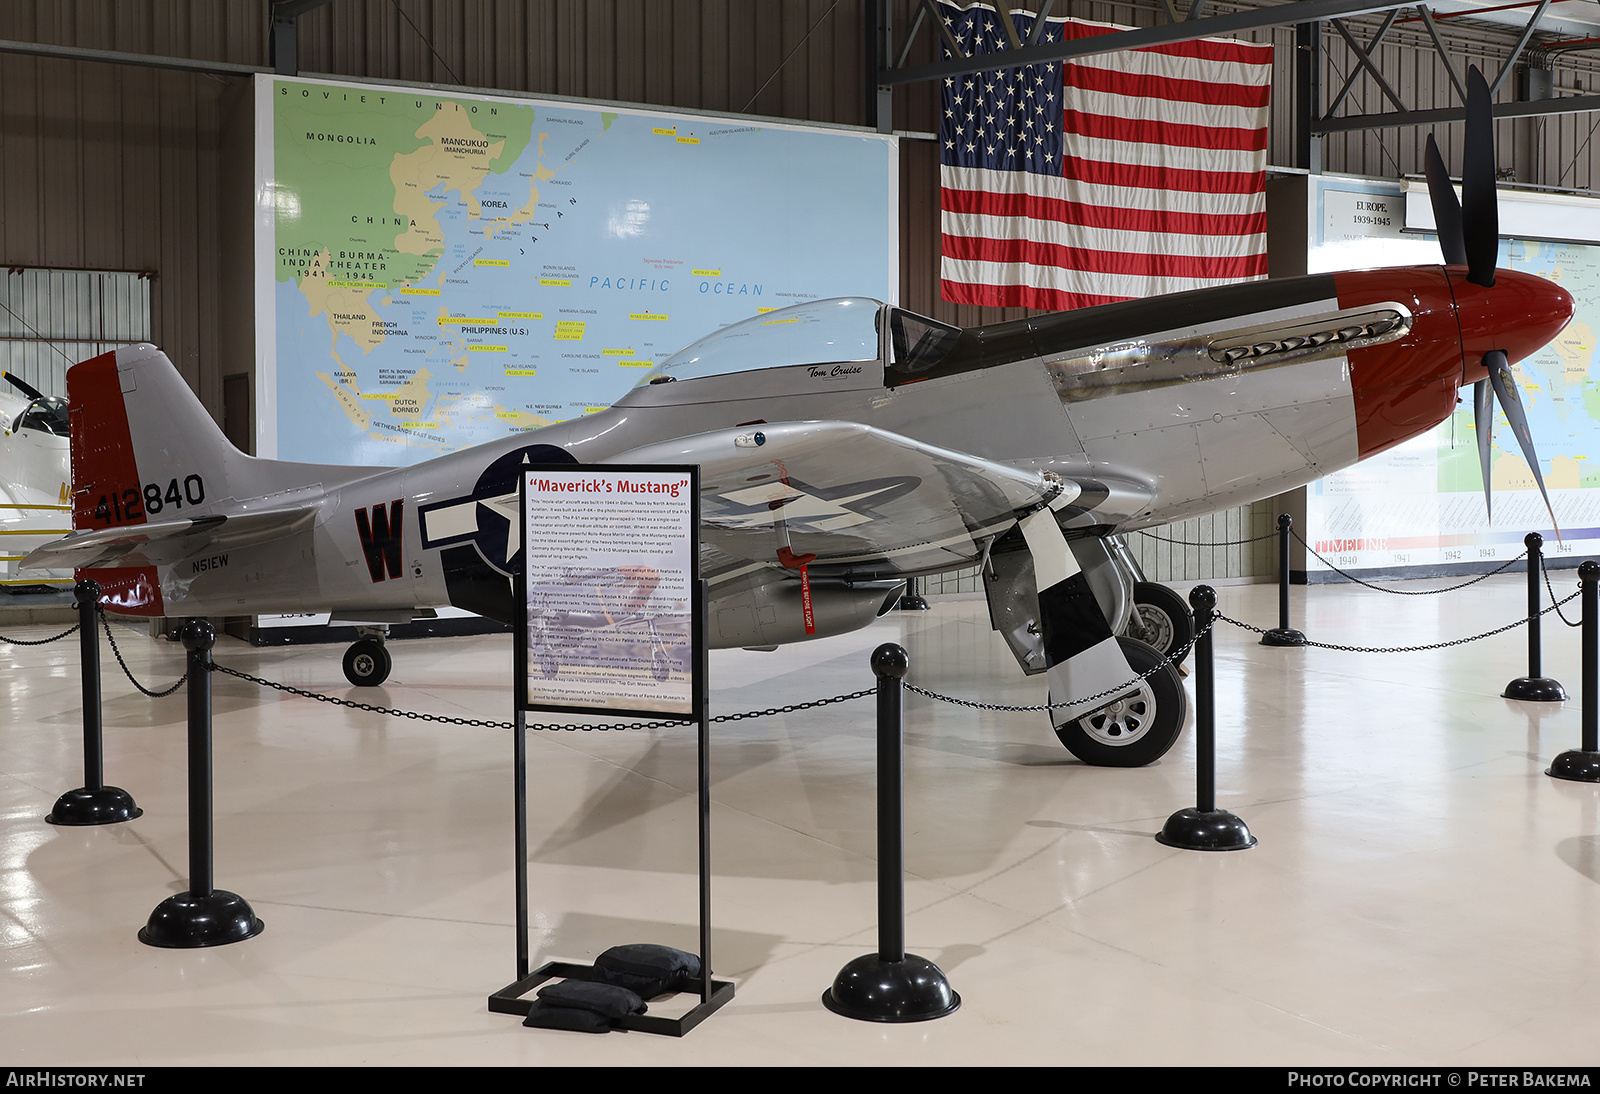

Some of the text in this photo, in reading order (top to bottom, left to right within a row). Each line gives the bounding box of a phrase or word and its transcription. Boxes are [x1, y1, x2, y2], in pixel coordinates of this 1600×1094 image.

[281, 88, 497, 115] SOVIET UNION
[306, 132, 376, 145] MONGOLIA
[441, 138, 488, 148] MANCUKUO
[565, 139, 590, 161] KURIL ISLANDS
[482, 200, 508, 208] KOREA
[1356, 201, 1387, 213] EUROPE,
[352, 216, 416, 226] CHINA
[519, 197, 576, 255] JAPAN
[1354, 215, 1390, 226] 1939-1945
[279, 249, 320, 257] CHINA
[468, 246, 484, 262] ISLANDS
[330, 261, 386, 270] THEATER
[589, 276, 763, 296] PACIFIC OCEAN
[461, 327, 528, 336] PHILIPPINES (U.S.)
[807, 366, 862, 378] Tom Cruise
[333, 386, 365, 423] SUMATRA
[373, 422, 414, 434] NETHERLANDS
[427, 434, 445, 443] INDIES
[94, 474, 205, 524] 412840
[354, 498, 404, 583] W
[1315, 538, 1388, 553] TIMELINE
[1339, 556, 1357, 565] 1940
[1393, 553, 1410, 563] 1941
[1445, 550, 1461, 559] 1942
[1479, 548, 1495, 558] 1943
[1556, 544, 1571, 553] 1944
[192, 554, 229, 574] N51EW
